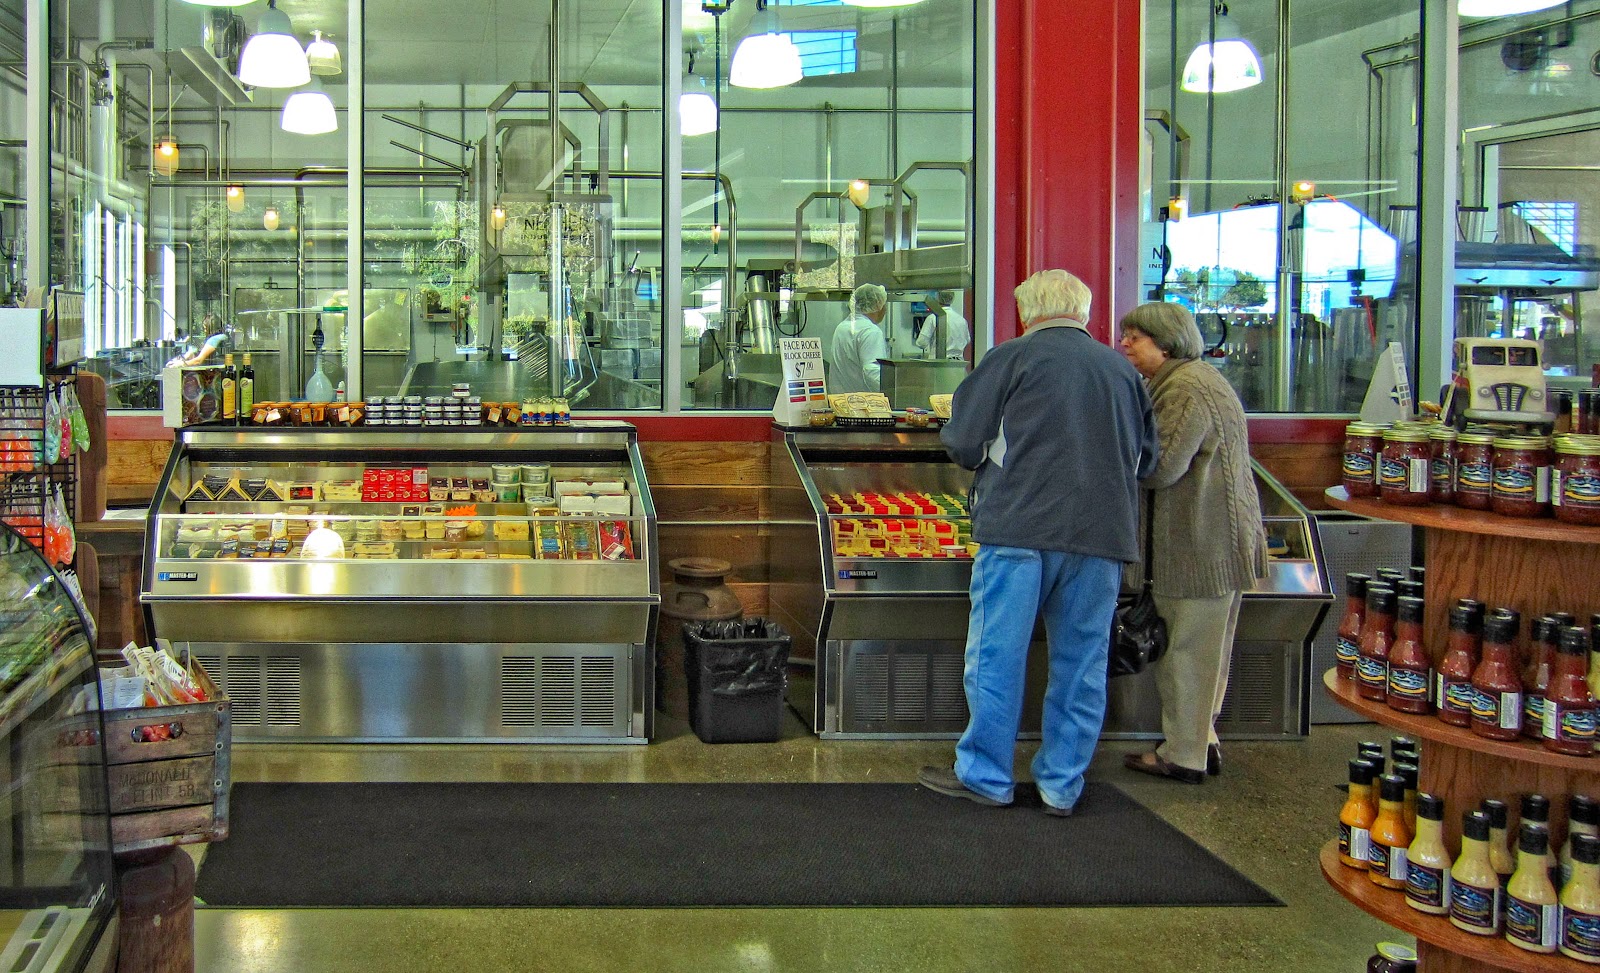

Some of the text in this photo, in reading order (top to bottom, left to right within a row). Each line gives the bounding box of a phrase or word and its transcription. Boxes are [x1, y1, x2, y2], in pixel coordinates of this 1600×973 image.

[783, 340, 820, 350] FACE ROCK
[784, 351, 821, 360] BLOCK CHEESE
